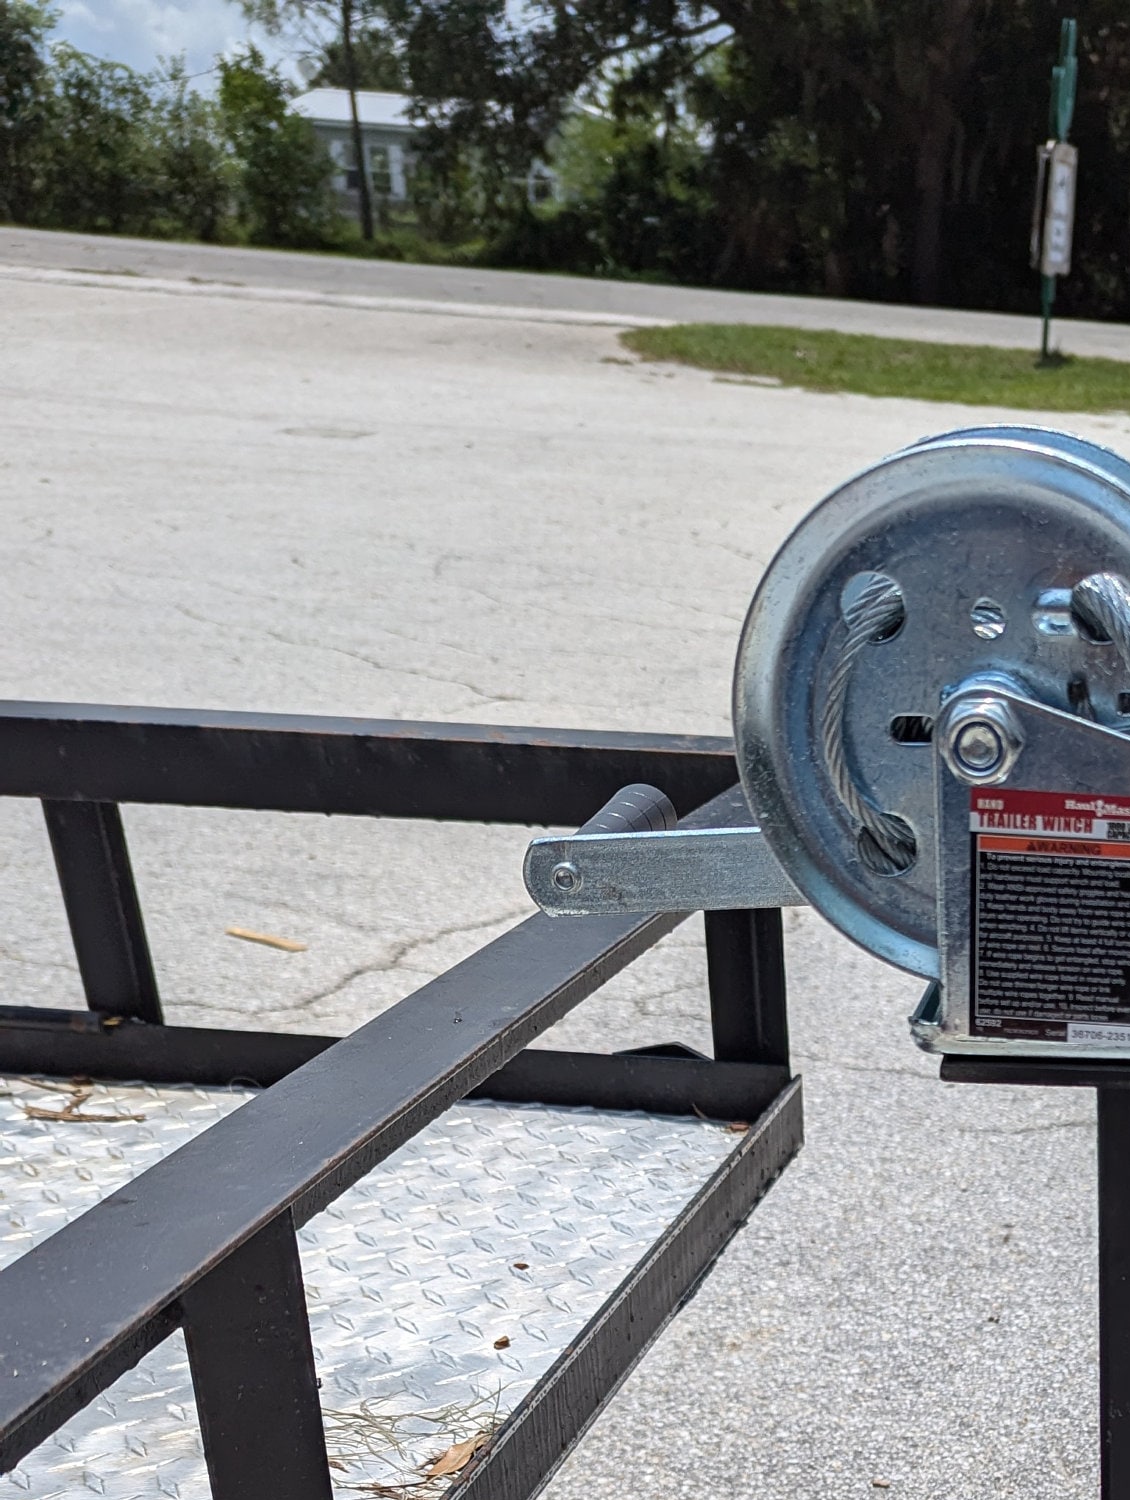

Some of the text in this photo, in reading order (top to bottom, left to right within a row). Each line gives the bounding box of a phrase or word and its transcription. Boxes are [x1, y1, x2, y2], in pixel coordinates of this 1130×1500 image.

[978, 812, 1092, 834] TRAILER WINCH
[1038, 842, 1100, 854] WARNING
